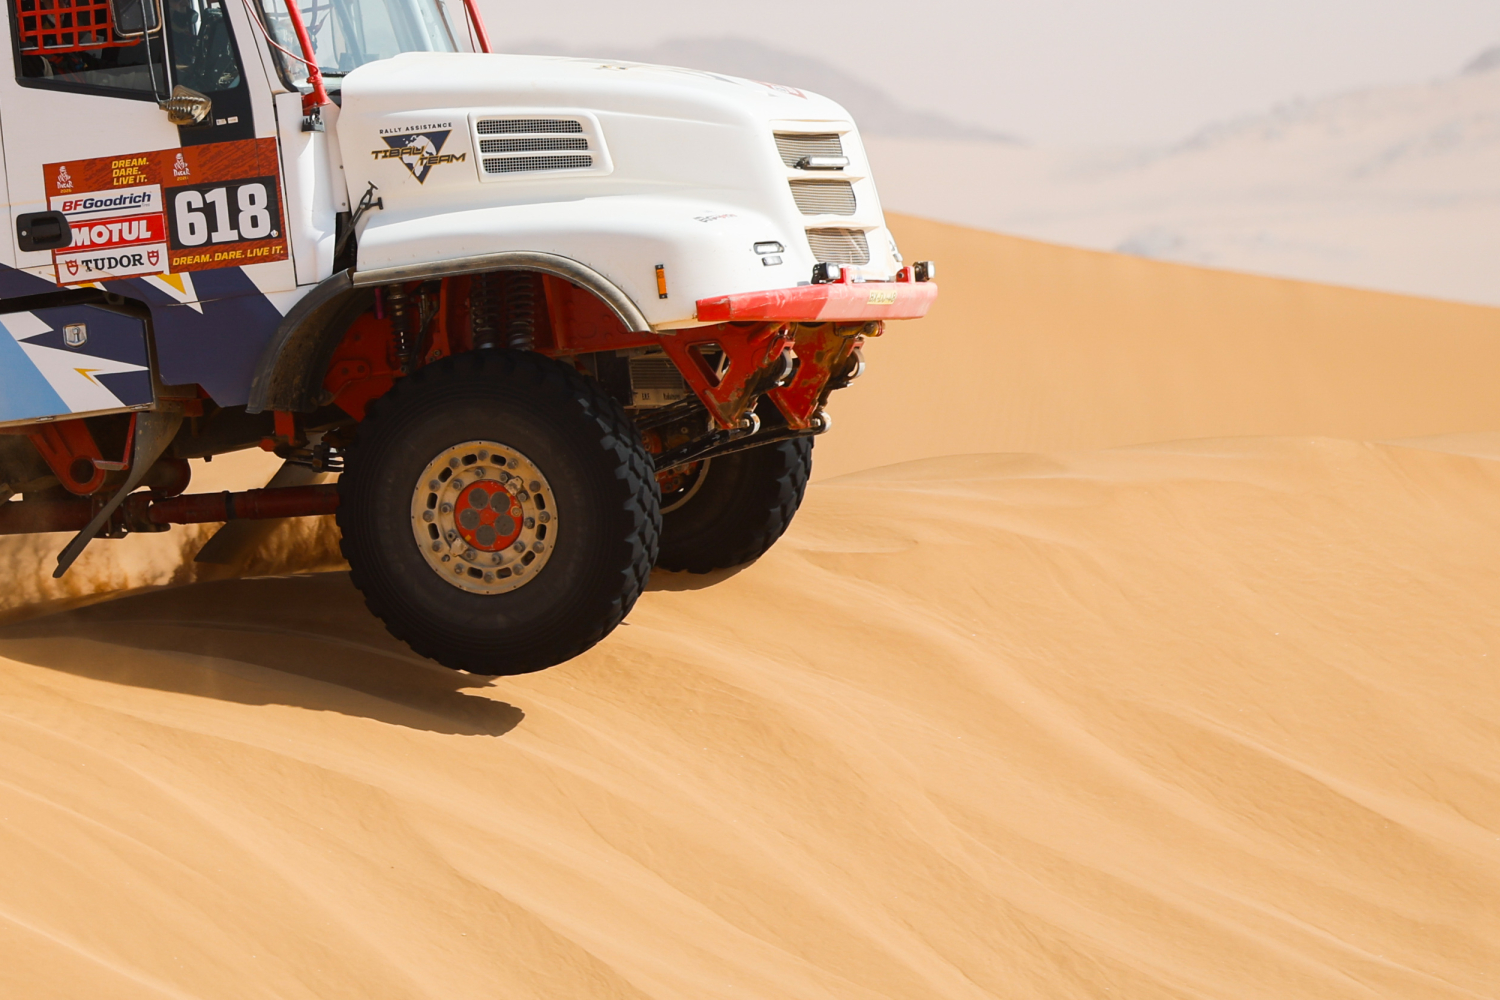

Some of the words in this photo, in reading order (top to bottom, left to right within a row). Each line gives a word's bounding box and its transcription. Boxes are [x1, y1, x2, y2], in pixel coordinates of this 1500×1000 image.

[405, 122, 452, 131] ASSISTANCE
[112, 158, 149, 168] DREAM.
[371, 146, 425, 160] TIBAU
[418, 152, 467, 166] TEAM
[112, 168, 141, 177] DARE.
[113, 176, 135, 185] LIVE
[136, 175, 147, 183] IT.
[62, 192, 151, 211] BFGoodrich
[174, 183, 271, 246] 618
[71, 220, 151, 247] MOTUL
[81, 253, 144, 272] TUDOR
[172, 254, 212, 266] DREAM.
[214, 251, 245, 261] DARE.
[247, 247, 270, 257] LIVE
[272, 246, 284, 255] IT.
